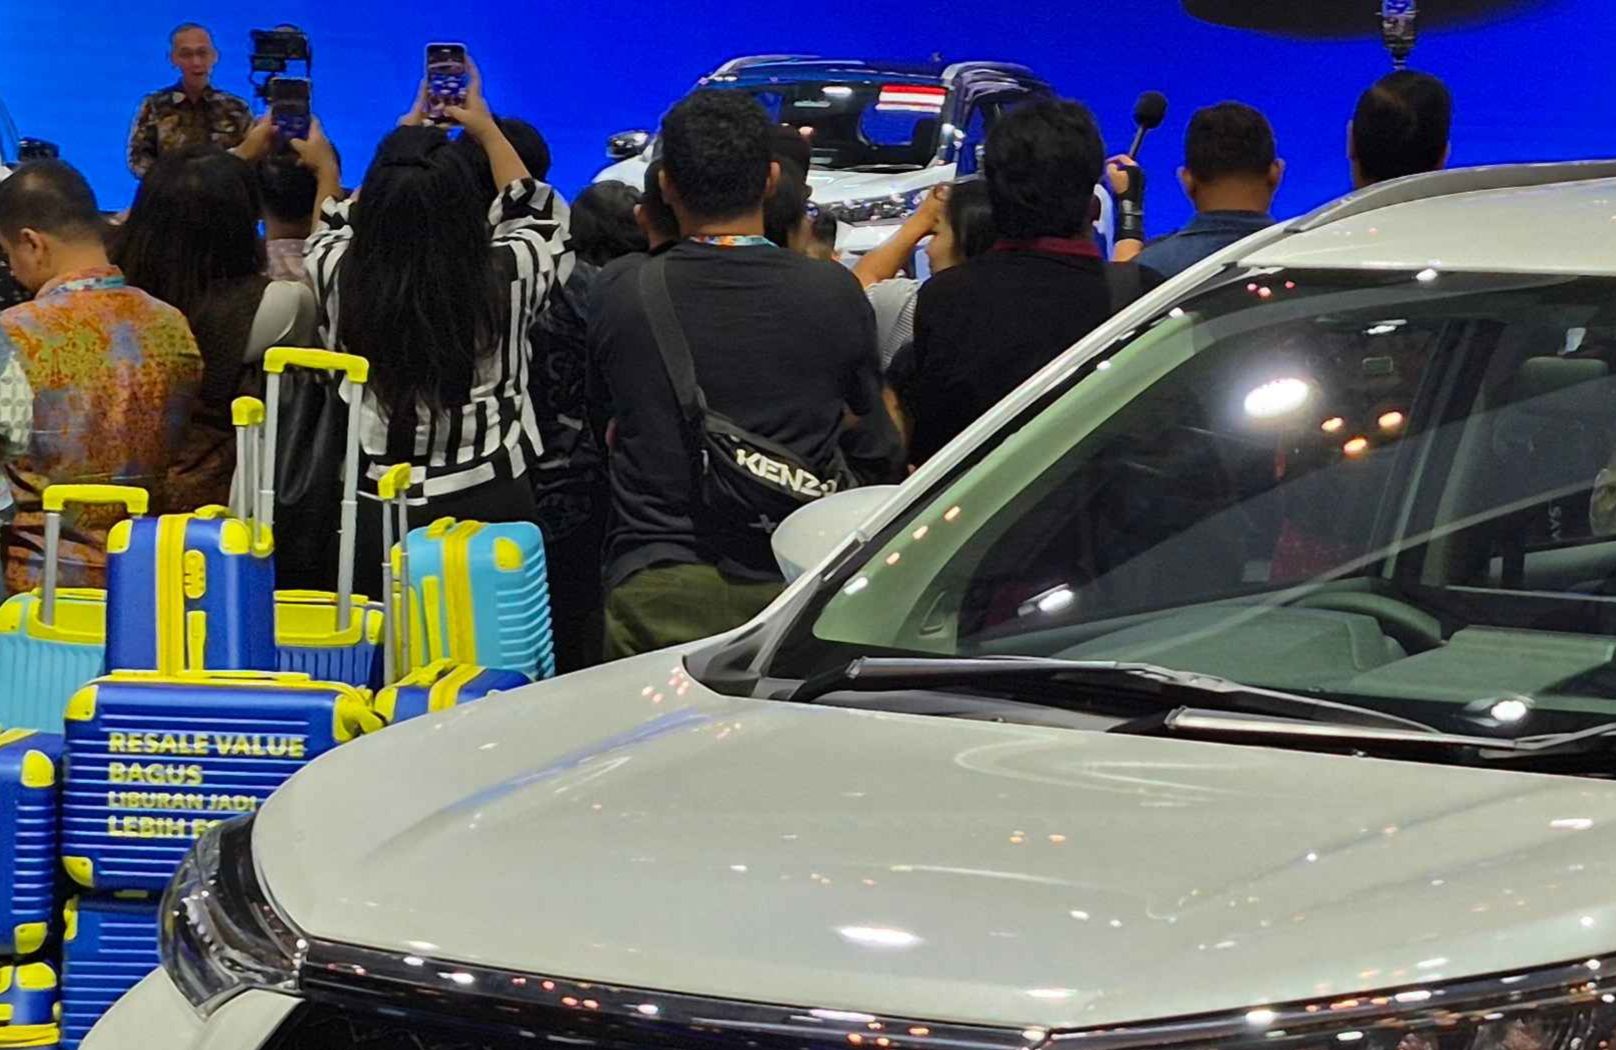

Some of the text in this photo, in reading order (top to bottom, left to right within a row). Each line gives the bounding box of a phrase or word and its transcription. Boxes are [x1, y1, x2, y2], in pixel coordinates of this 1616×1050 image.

[108, 732, 304, 757] RESALE VALUE
[108, 762, 203, 785] BAGUS
[108, 791, 258, 812] LIBURAN JADI
[108, 815, 185, 838] LEBIH
